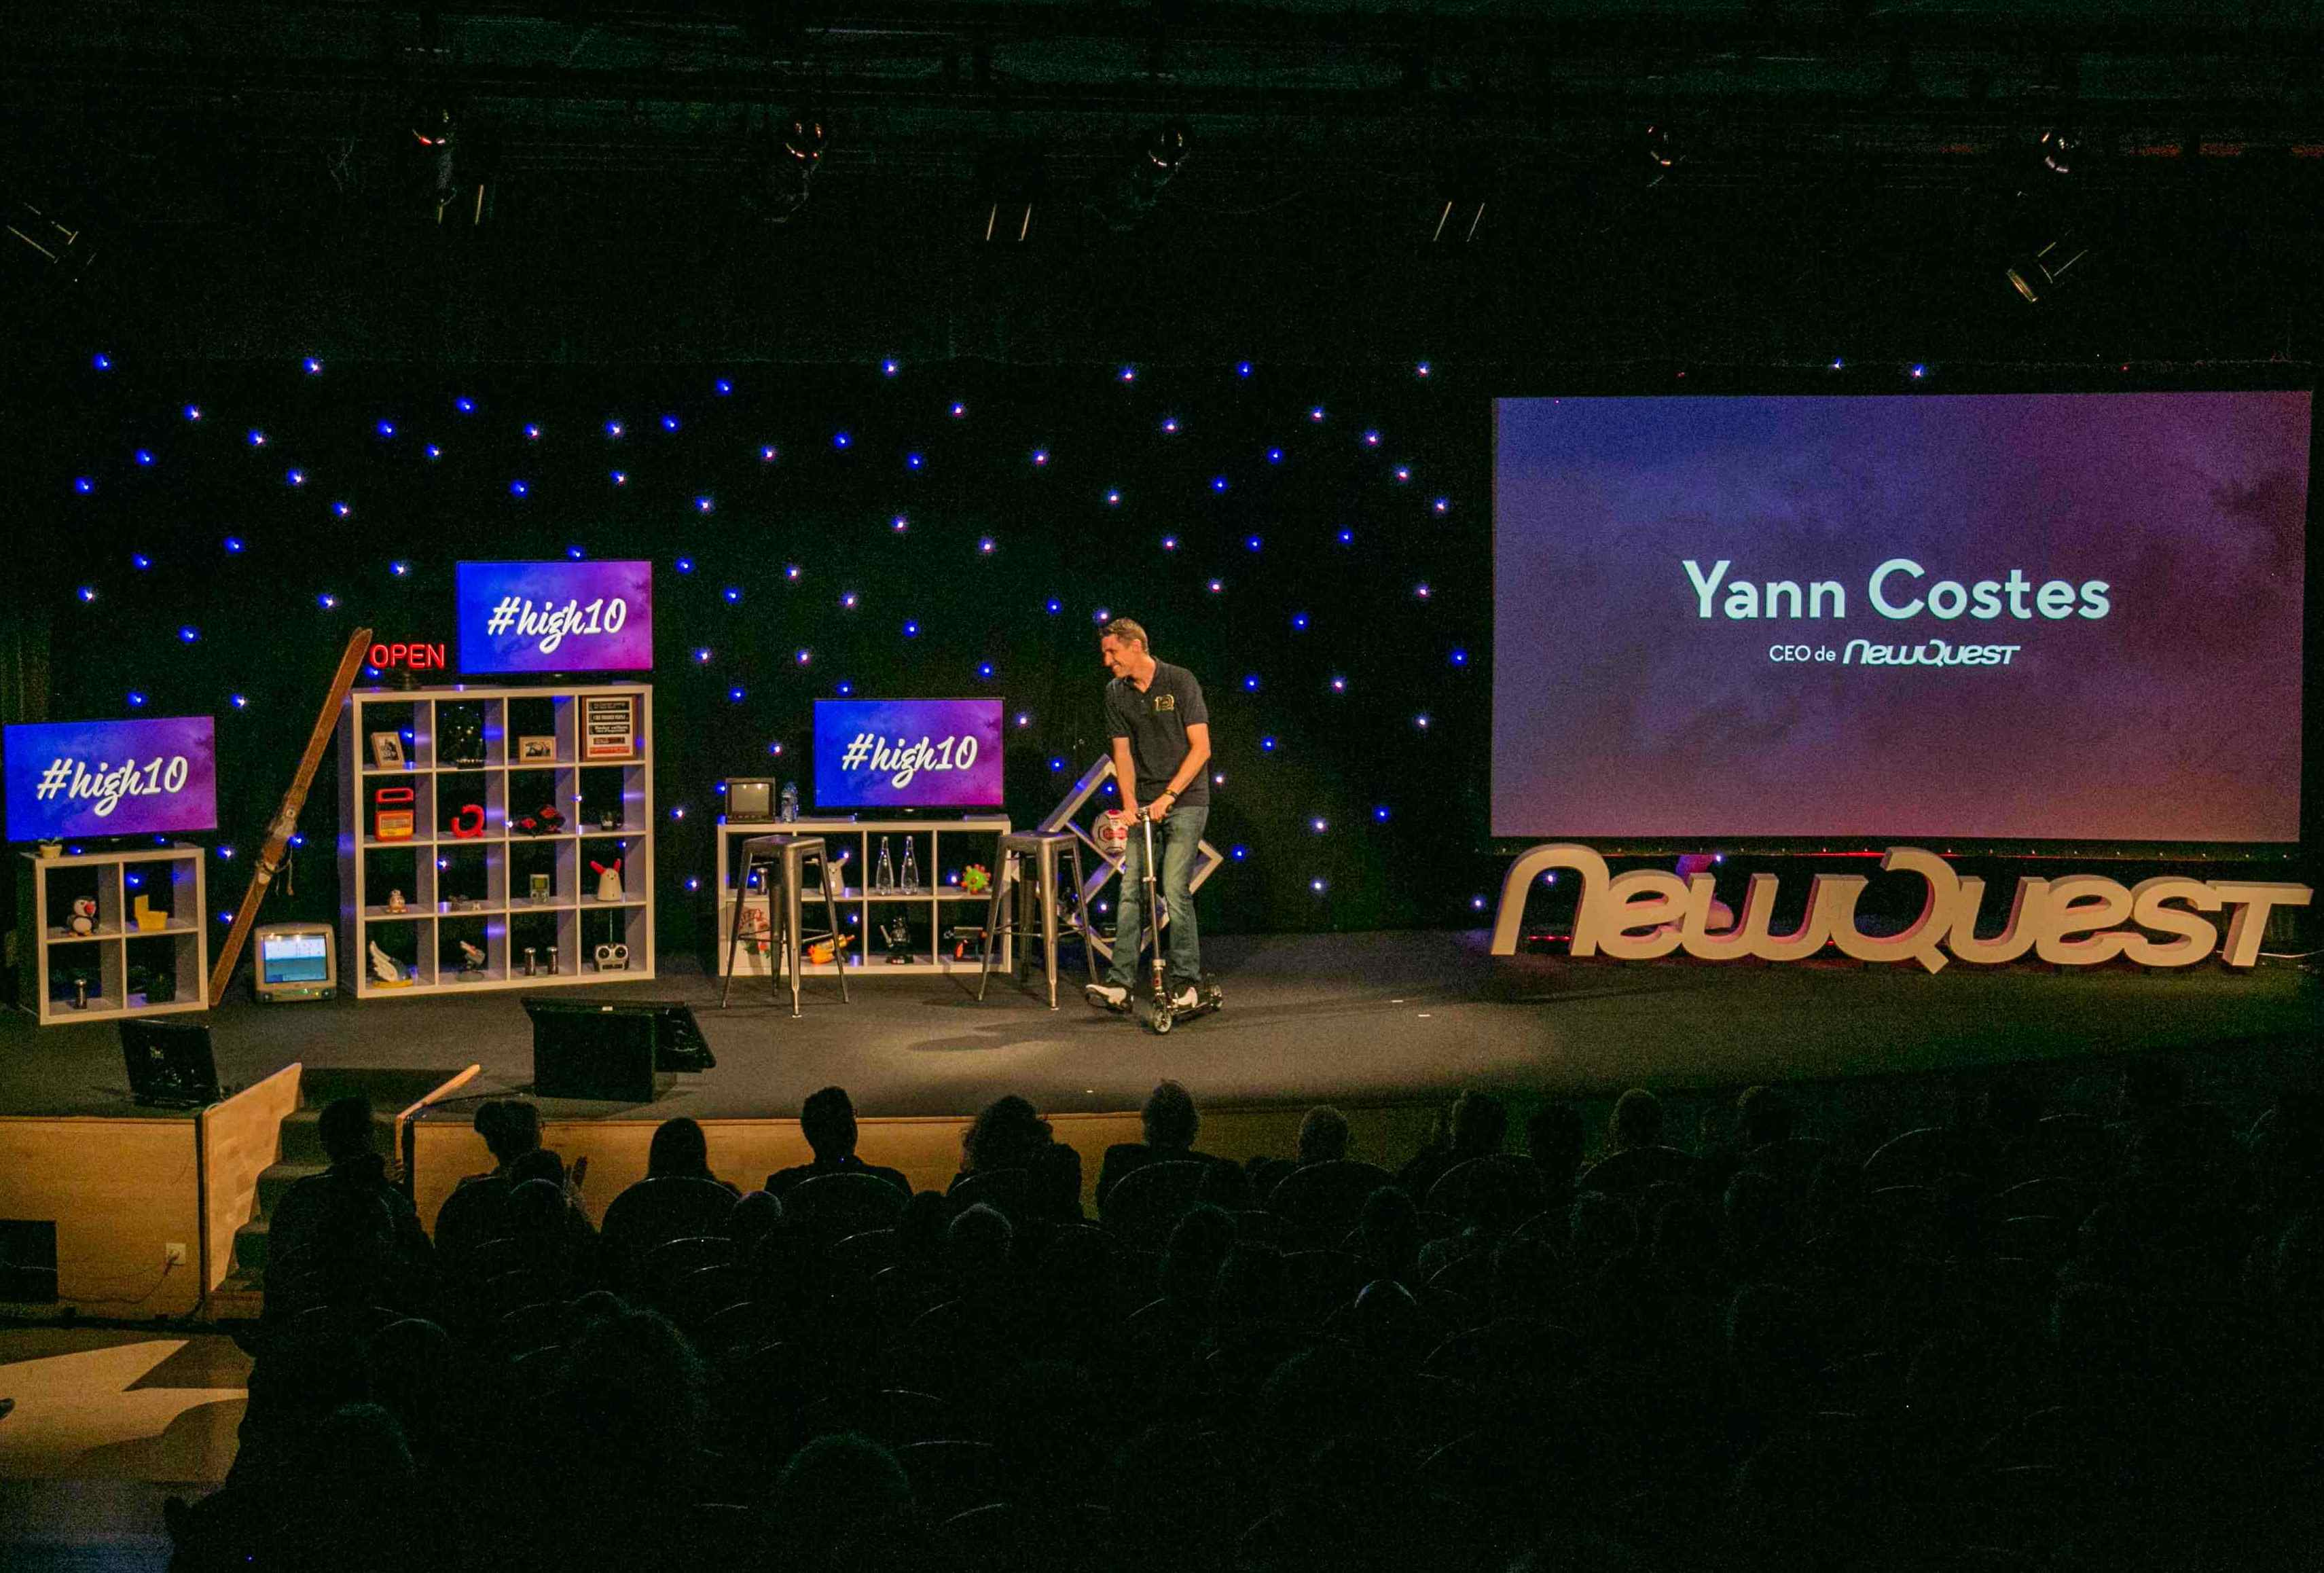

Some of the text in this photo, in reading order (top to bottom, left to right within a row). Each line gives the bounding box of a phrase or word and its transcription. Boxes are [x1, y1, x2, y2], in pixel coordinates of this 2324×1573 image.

[1683, 558, 2111, 619] Yann Costes
[488, 596, 626, 654] #high10
[1769, 645, 1811, 662] CEO
[1814, 645, 1836, 662] de
[370, 644, 445, 668] OPEN
[37, 756, 188, 817] #high10
[842, 733, 978, 789] #high10
